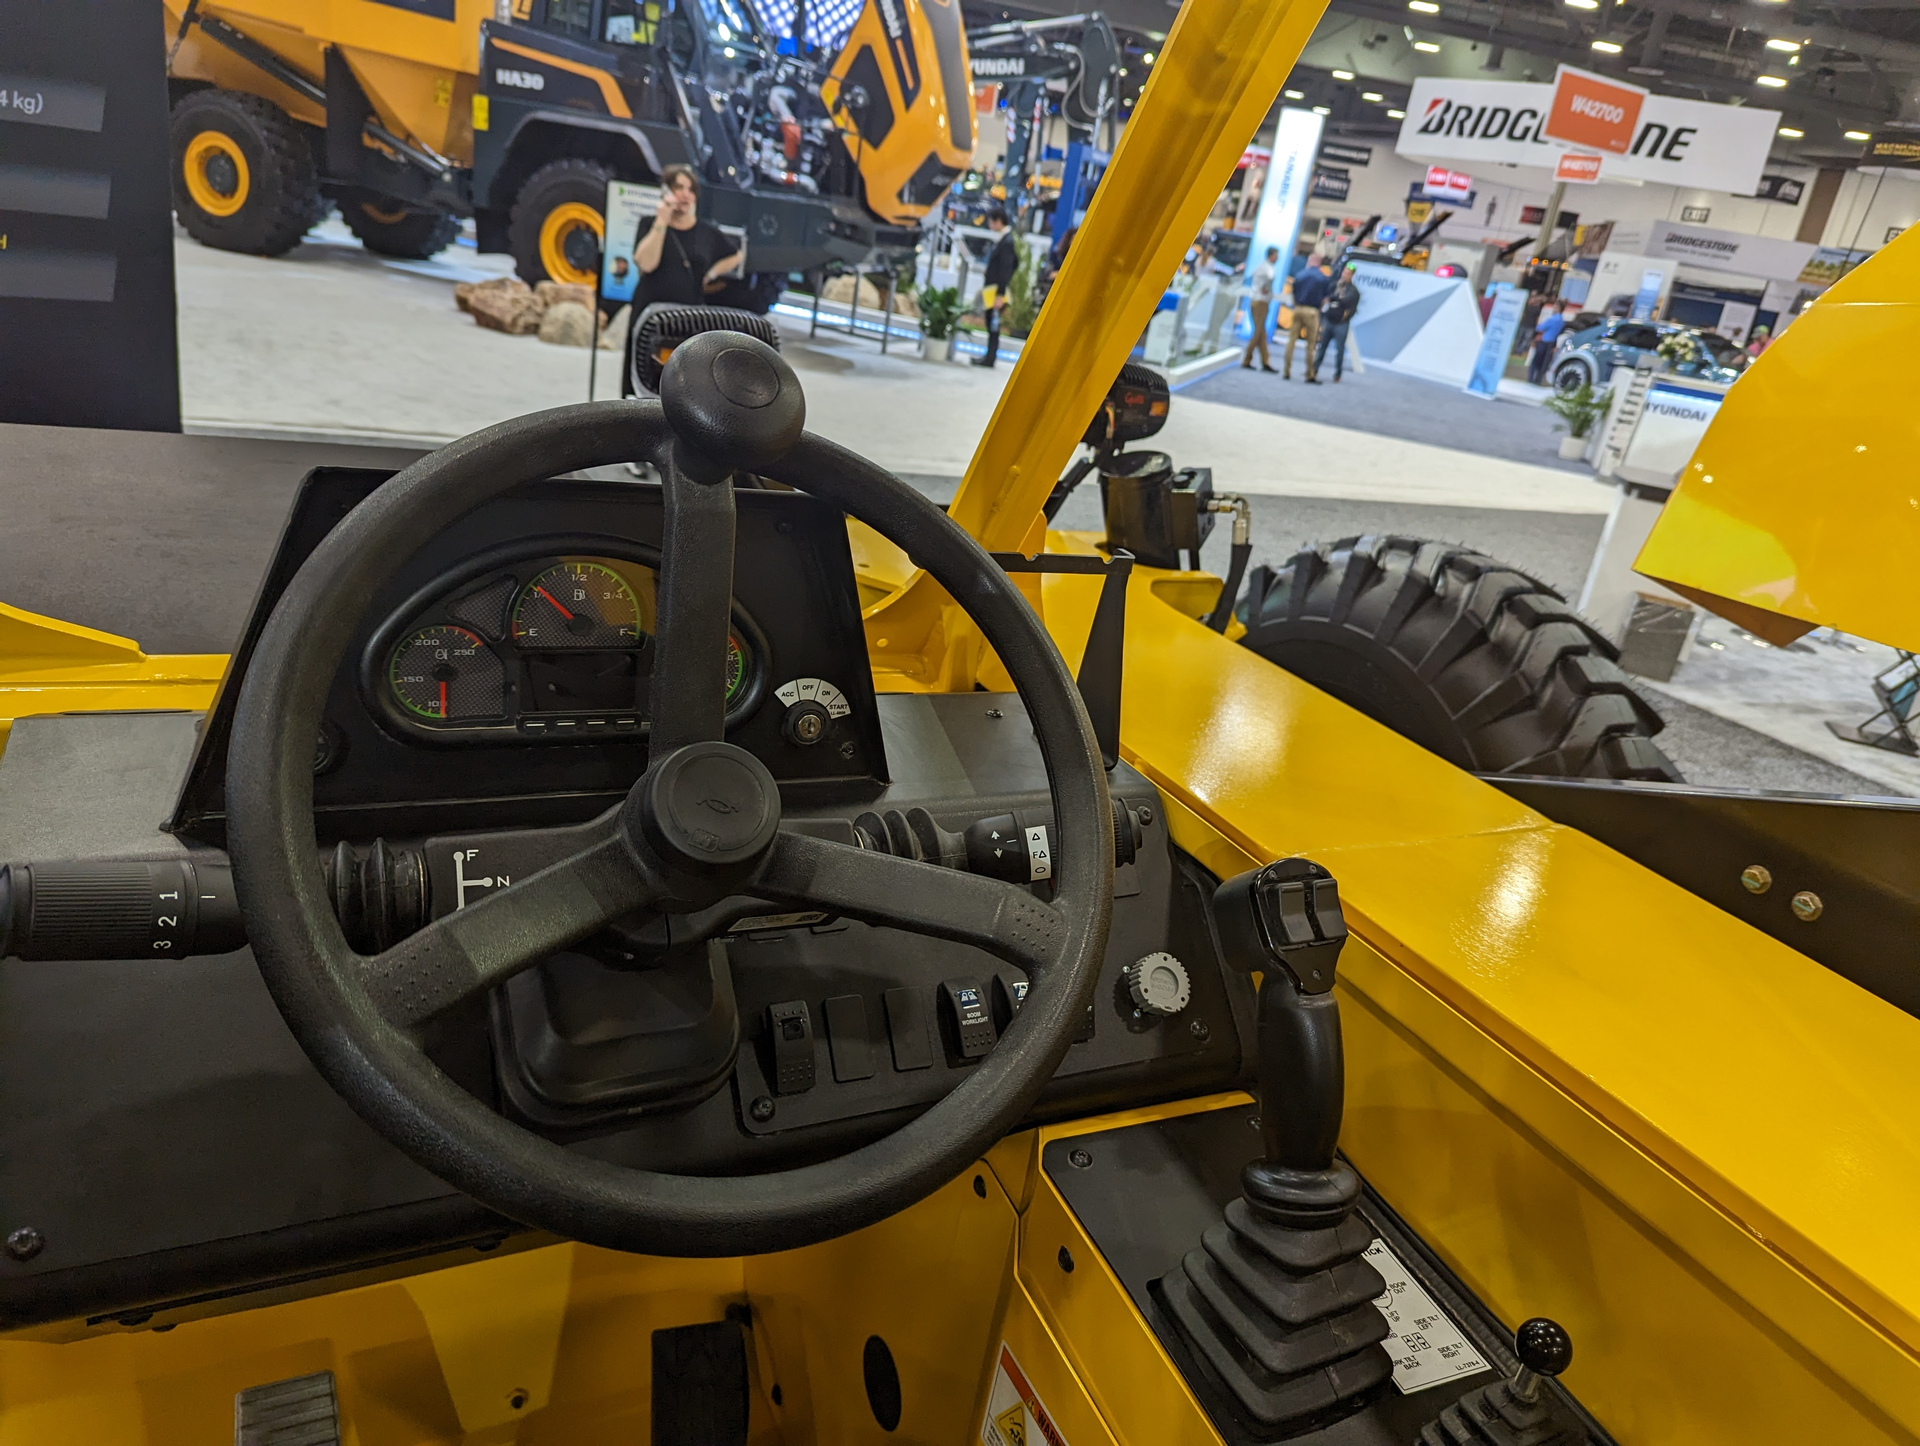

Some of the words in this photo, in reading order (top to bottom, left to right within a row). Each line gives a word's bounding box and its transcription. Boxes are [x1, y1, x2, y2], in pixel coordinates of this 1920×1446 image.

[970, 58, 1025, 75] YUNDAI
[496, 68, 545, 91] HA30
[13, 91, 43, 114] kg)
[1570, 94, 1624, 124] W42700
[1417, 98, 1697, 161] BRIDGNE
[1665, 232, 1739, 253] BRIDGESTONE
[571, 574, 588, 582] 1/2
[603, 592, 623, 600] 3/4
[466, 850, 479, 861] F
[497, 875, 510, 887] N
[159, 891, 178, 900] 1
[158, 915, 177, 927] 2
[153, 940, 172, 949] 3
[966, 1011, 981, 1019] BOOM
[961, 1016, 989, 1026] WORKLIGHT
[1363, 1247, 1384, 1258] TICK
[1388, 1281, 1407, 1290] BOOM
[1385, 1310, 1399, 1318] LIFT
[1413, 1317, 1429, 1326] SIDE
[1426, 1314, 1440, 1322] TILT
[1418, 1323, 1433, 1331] LEFT
[1437, 1345, 1452, 1354] SIDE
[1441, 1350, 1461, 1359] RIGHT
[1393, 1358, 1405, 1367] ORK
[1403, 1355, 1417, 1363] TILT
[1403, 1361, 1422, 1370] BACK
